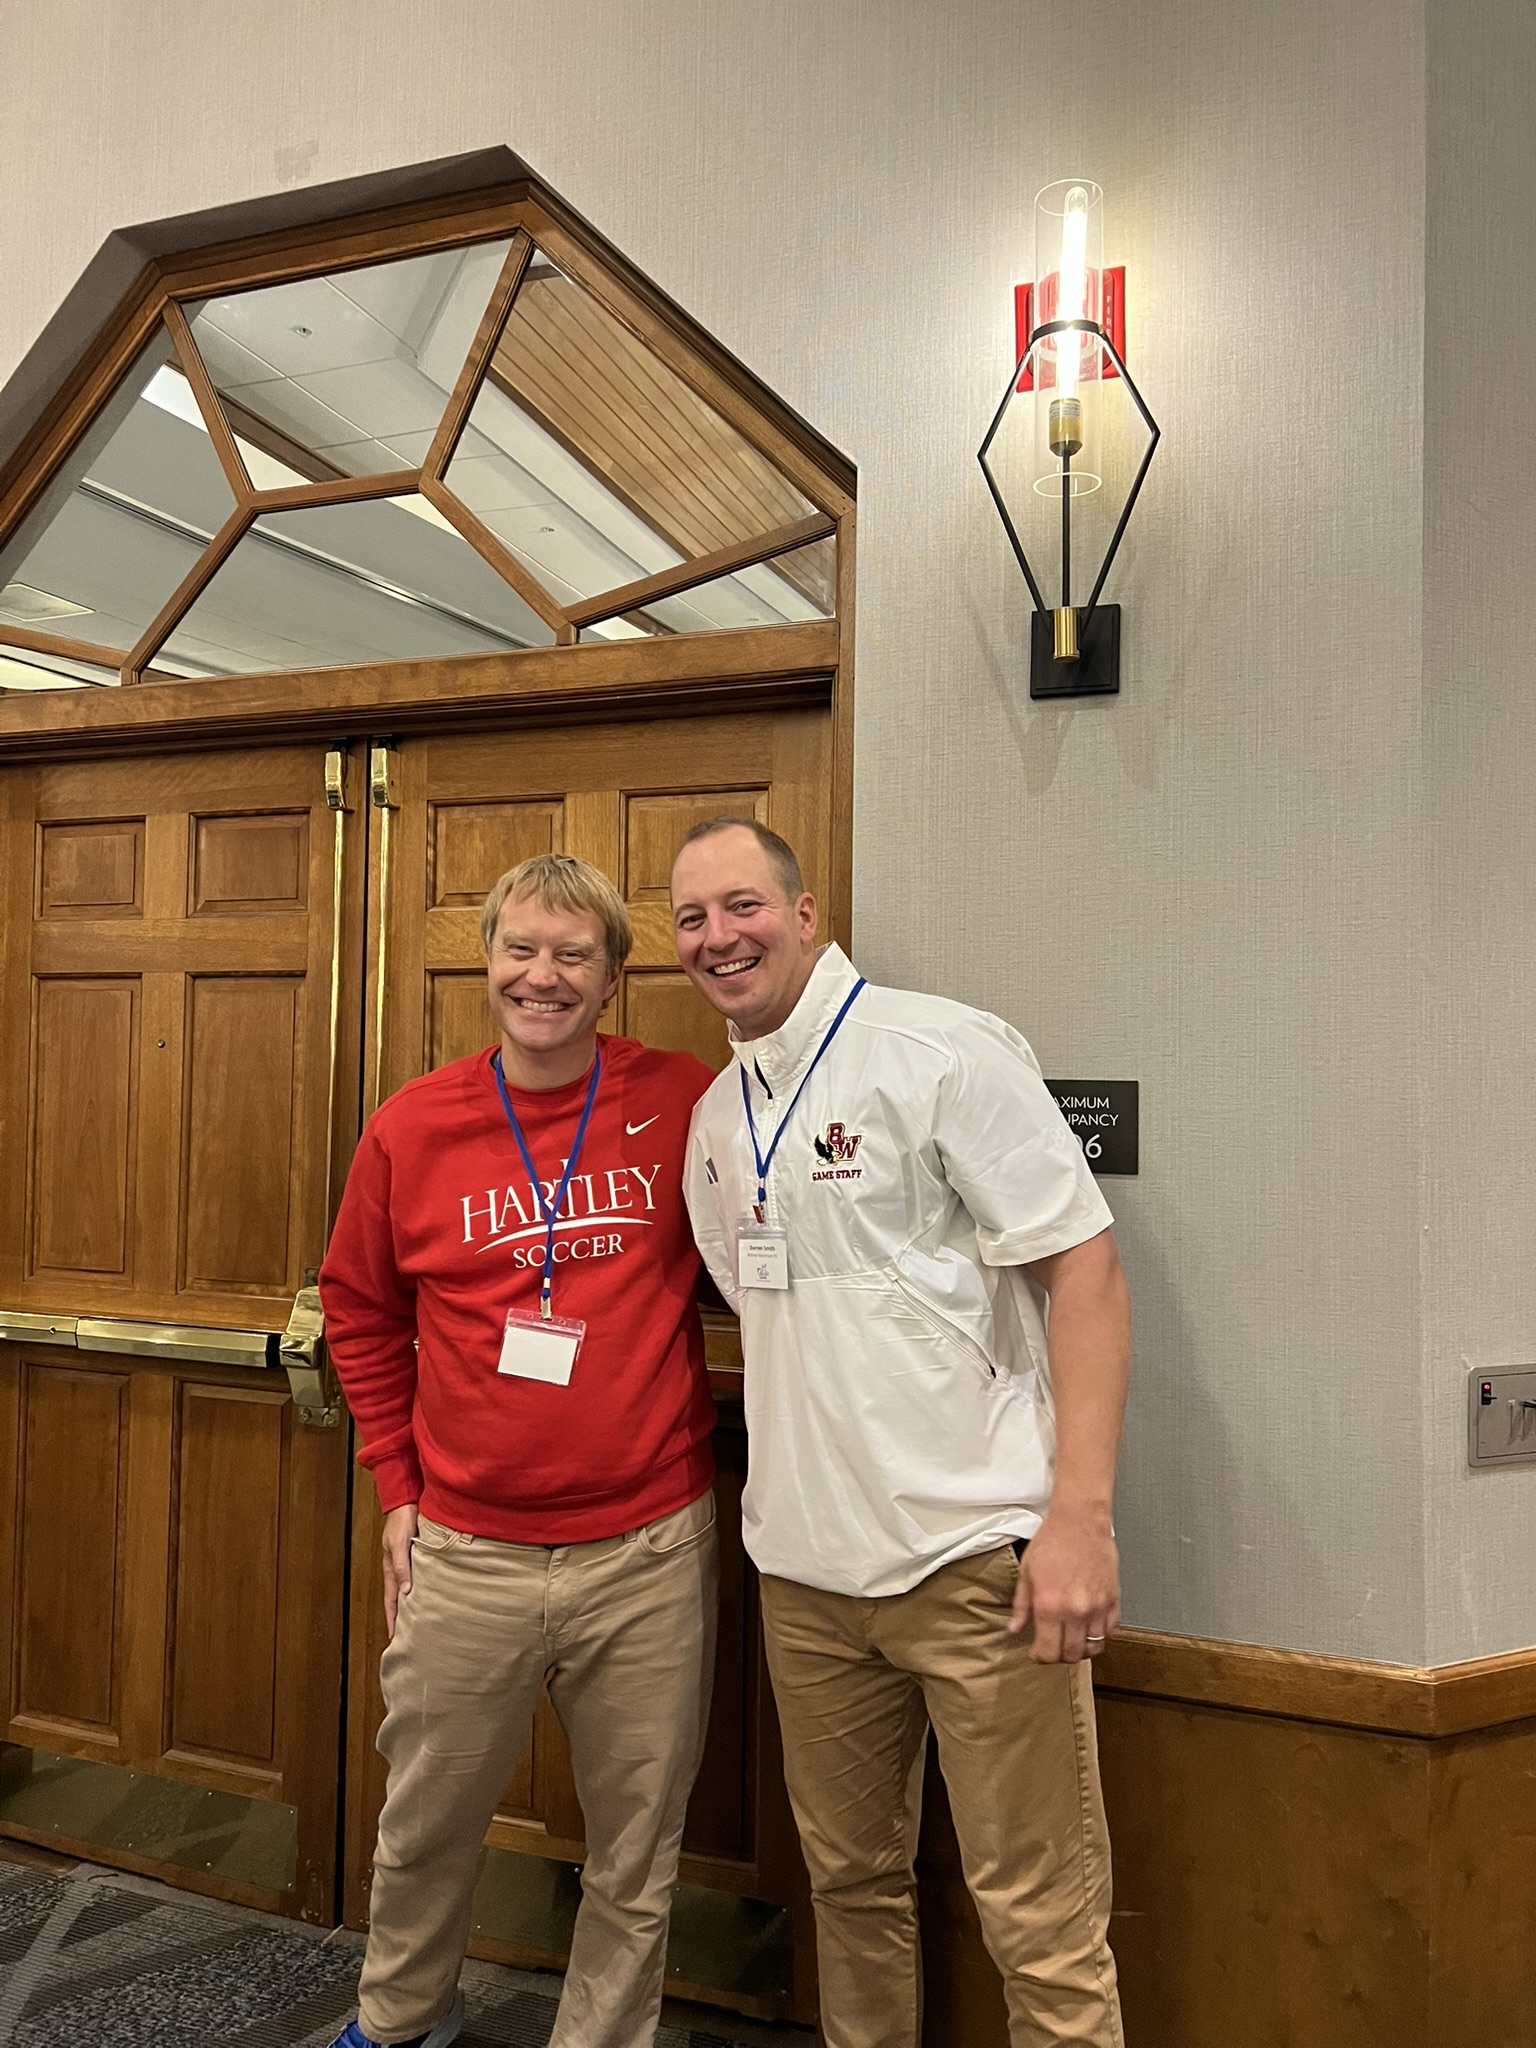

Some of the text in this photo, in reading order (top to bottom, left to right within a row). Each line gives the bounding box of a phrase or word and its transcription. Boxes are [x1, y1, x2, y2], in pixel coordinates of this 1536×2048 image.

[827, 1122, 862, 1162] BW
[812, 1169, 862, 1181] GAME STAFF
[459, 1158, 662, 1243] HARTLEY
[512, 1233, 624, 1269] SOCCER
